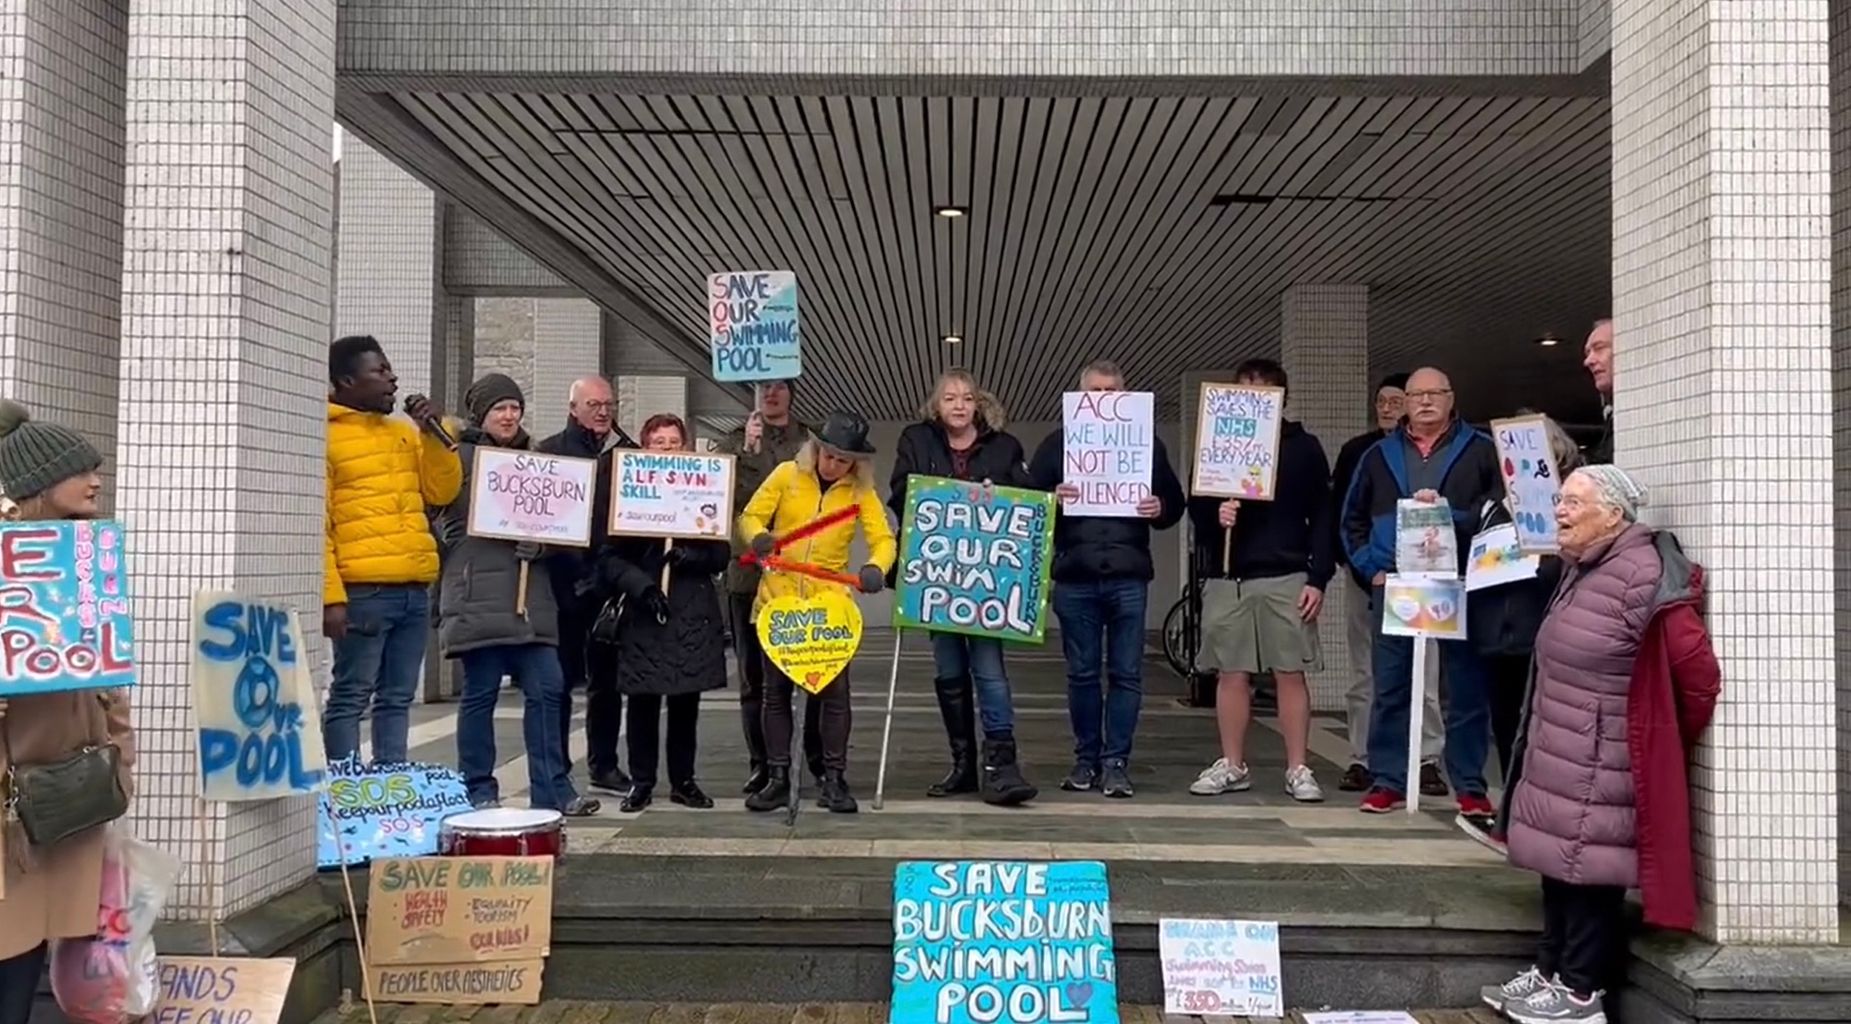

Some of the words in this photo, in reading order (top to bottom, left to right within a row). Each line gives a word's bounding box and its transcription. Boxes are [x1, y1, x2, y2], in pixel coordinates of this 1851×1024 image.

[712, 274, 771, 299] SAVE
[713, 299, 760, 323] OUR
[714, 319, 799, 346] SWIMMING
[717, 347, 771, 373] POOL
[1073, 392, 1133, 422] ACC
[1065, 423, 1094, 445] WE
[1102, 423, 1149, 447] WILL
[1216, 417, 1255, 437] NHS
[1500, 429, 1538, 450] SAVE
[514, 454, 560, 476] SAVE
[623, 454, 702, 471] SWIMMING
[708, 458, 721, 472] IS
[1066, 449, 1111, 473] NOT
[1117, 450, 1143, 474] BE
[1200, 447, 1237, 464] EVERY
[1238, 451, 1272, 467] YEAR
[487, 471, 586, 502] BUCKSBURN
[623, 469, 633, 482] A
[635, 470, 663, 484] LF
[665, 470, 718, 487] SVN
[619, 484, 662, 500] SKILL
[513, 494, 555, 516] POOL
[915, 499, 1035, 538] SAVE
[920, 534, 1022, 569] OUR
[769, 607, 828, 631] SAVE
[920, 583, 1033, 635] POOL
[200, 601, 297, 663] SAVE
[768, 628, 807, 647] OUR
[811, 625, 853, 642] POOL
[1, 622, 134, 678] POOL
[234, 655, 305, 733] OUR
[200, 728, 327, 795] POOL
[330, 774, 417, 808] SOS
[379, 814, 425, 834] SOS
[380, 860, 451, 891] SAVE
[458, 861, 494, 889] OUR
[929, 862, 1049, 897] SAVE
[404, 891, 448, 912] HEALTH
[401, 909, 445, 930] SAFETY
[473, 910, 518, 924] TOURISM
[158, 961, 239, 1002] ANDS
[379, 970, 428, 995] PEOPLE
[431, 968, 463, 993] OVER
[1249, 975, 1278, 991] NHS
[936, 982, 1089, 1023] POOL
